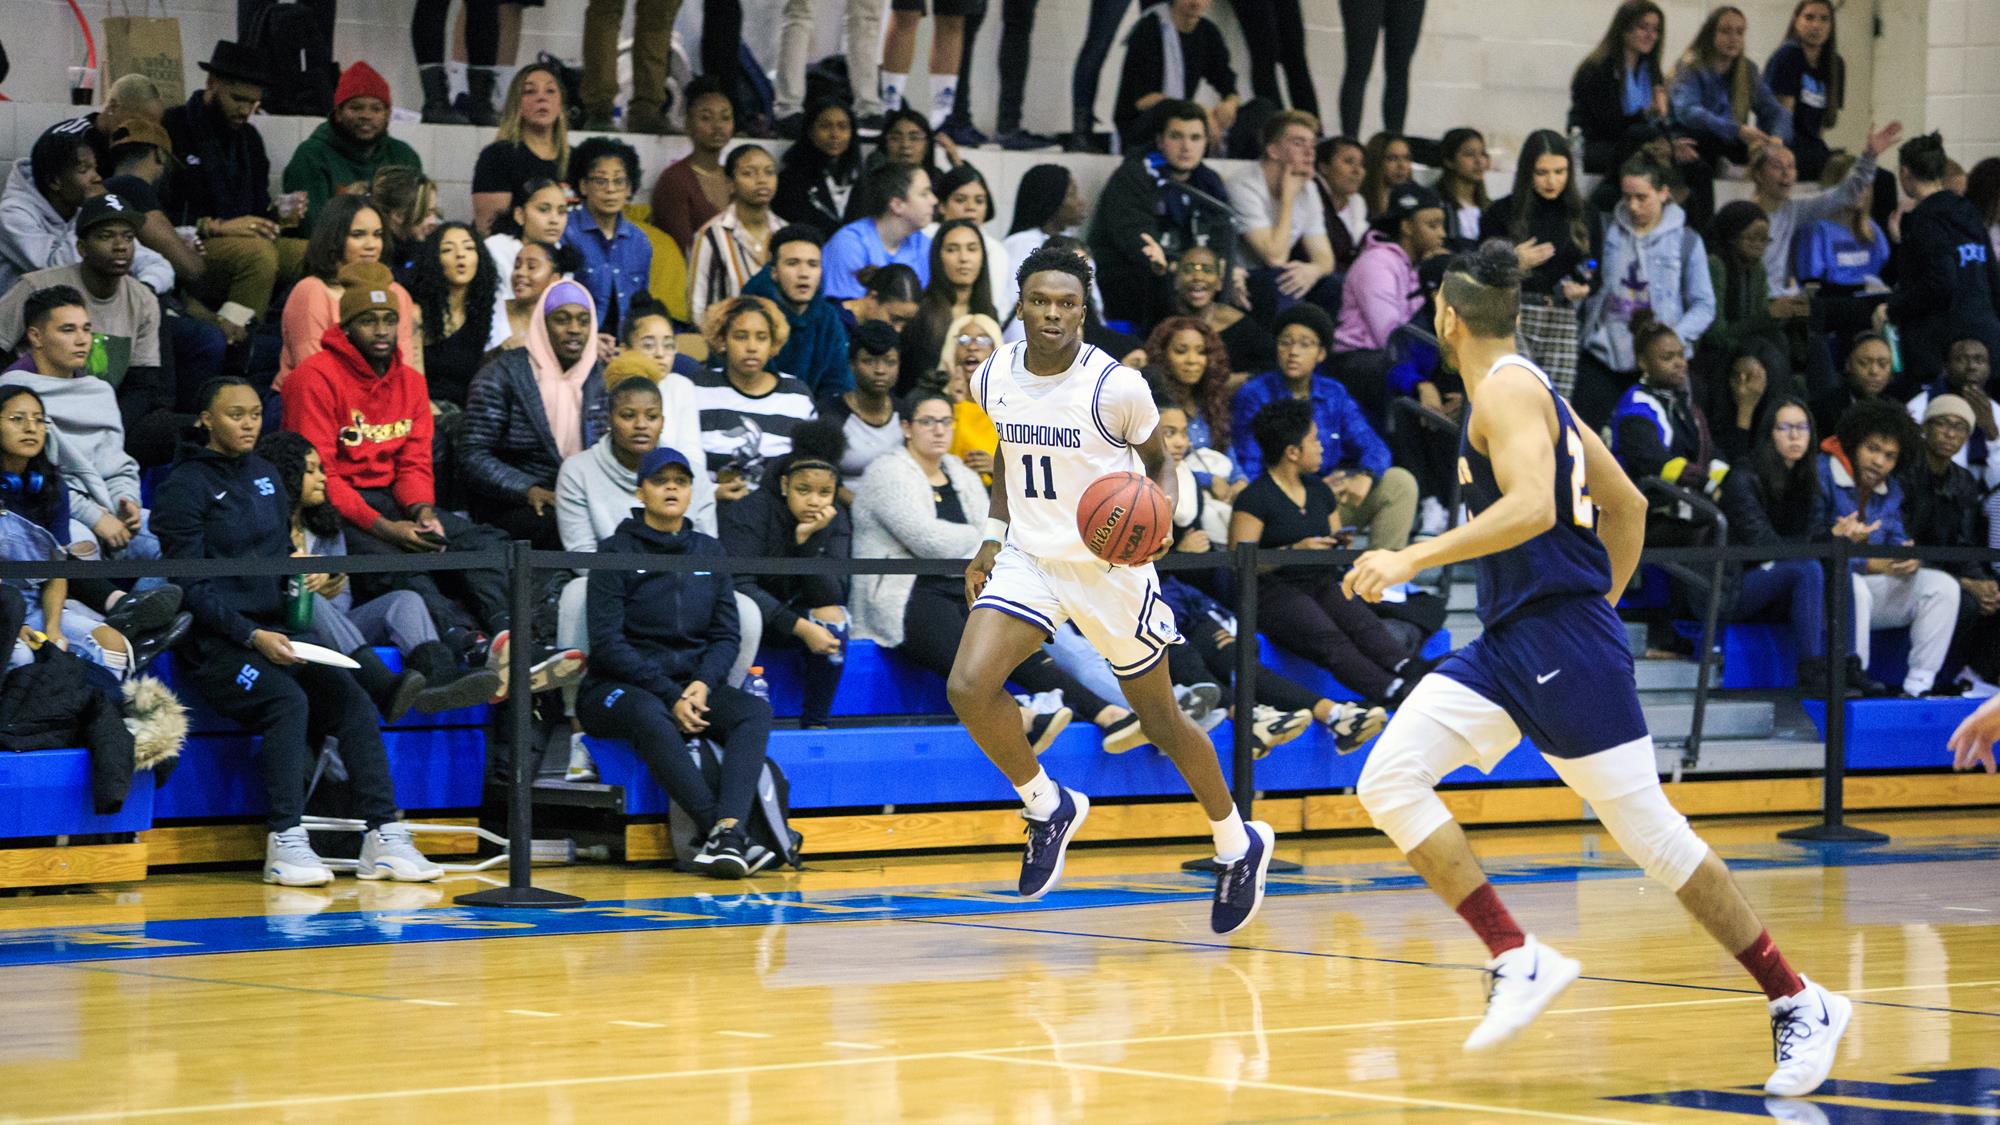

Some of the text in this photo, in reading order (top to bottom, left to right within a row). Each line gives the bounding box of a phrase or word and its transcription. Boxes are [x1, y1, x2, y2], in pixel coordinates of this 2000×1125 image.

[253, 477, 275, 496] 35
[1021, 454, 1057, 500] 11
[1088, 506, 1125, 555] Wilson
[236, 664, 260, 690] 35
